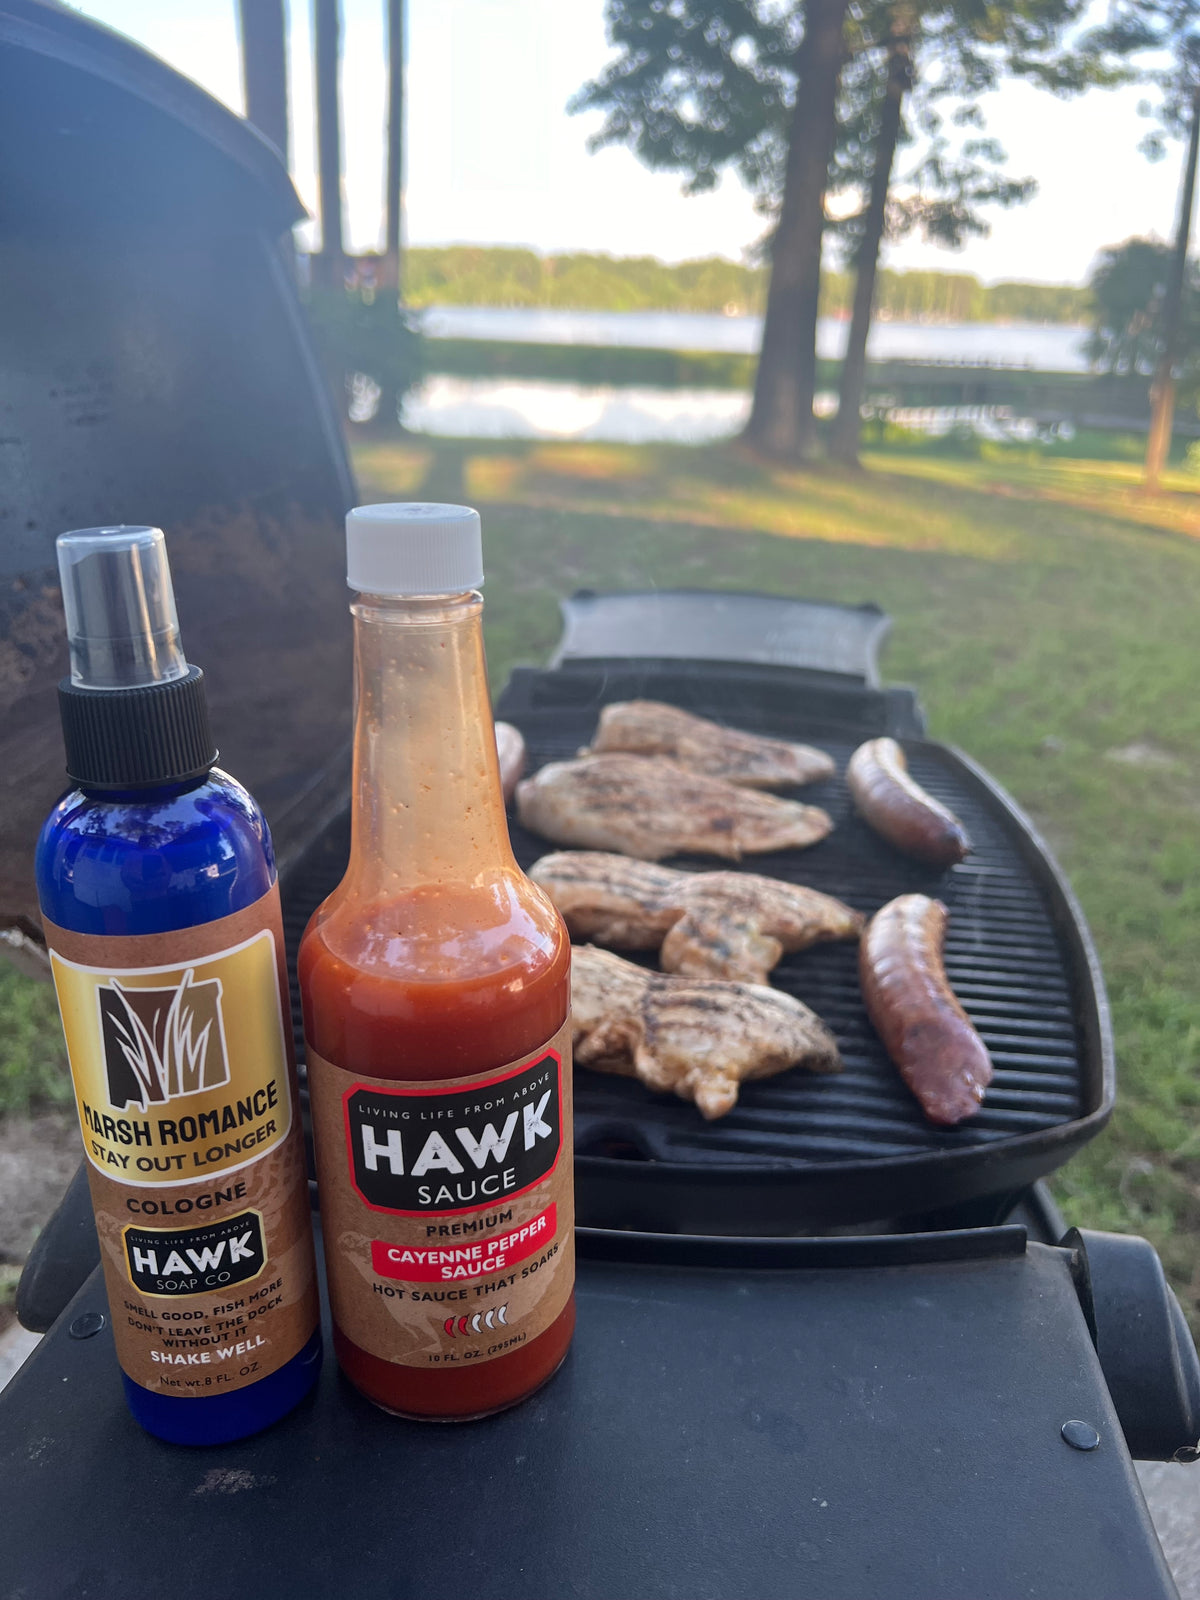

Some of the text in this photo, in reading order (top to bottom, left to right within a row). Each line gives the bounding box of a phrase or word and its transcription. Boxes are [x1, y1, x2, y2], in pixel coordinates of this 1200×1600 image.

[83, 1080, 278, 1146] MARSH ROMANCE
[359, 1072, 549, 1119] LIVING LIFE FROM ABOVE
[92, 1120, 277, 1172] STAY OUT LONGER
[361, 1089, 552, 1176] HAWK
[127, 1182, 247, 1215] COLOGNE
[418, 1167, 516, 1204] SAUCE
[131, 1236, 159, 1244] LIVING
[190, 1233, 215, 1242] FROM
[221, 1221, 250, 1235] ABOVE
[388, 1216, 546, 1264] CAYENNE PEPPER
[426, 1209, 513, 1237] PREMIUM
[133, 1231, 255, 1276] HAWK
[373, 1243, 559, 1301] HOT SAUCE THAT SOARS
[441, 1254, 505, 1279] SAUCE
[124, 1301, 157, 1318] SMELL
[213, 1299, 245, 1315] FISH
[249, 1278, 283, 1303] MORE
[157, 1271, 231, 1290] SOAP CO
[128, 1295, 282, 1336] DON'T LEAVE THE DOCK
[150, 1335, 265, 1365] SHAKE WELL
[162, 1326, 248, 1348] WITHOUT IT
[160, 1376, 180, 1386] Net
